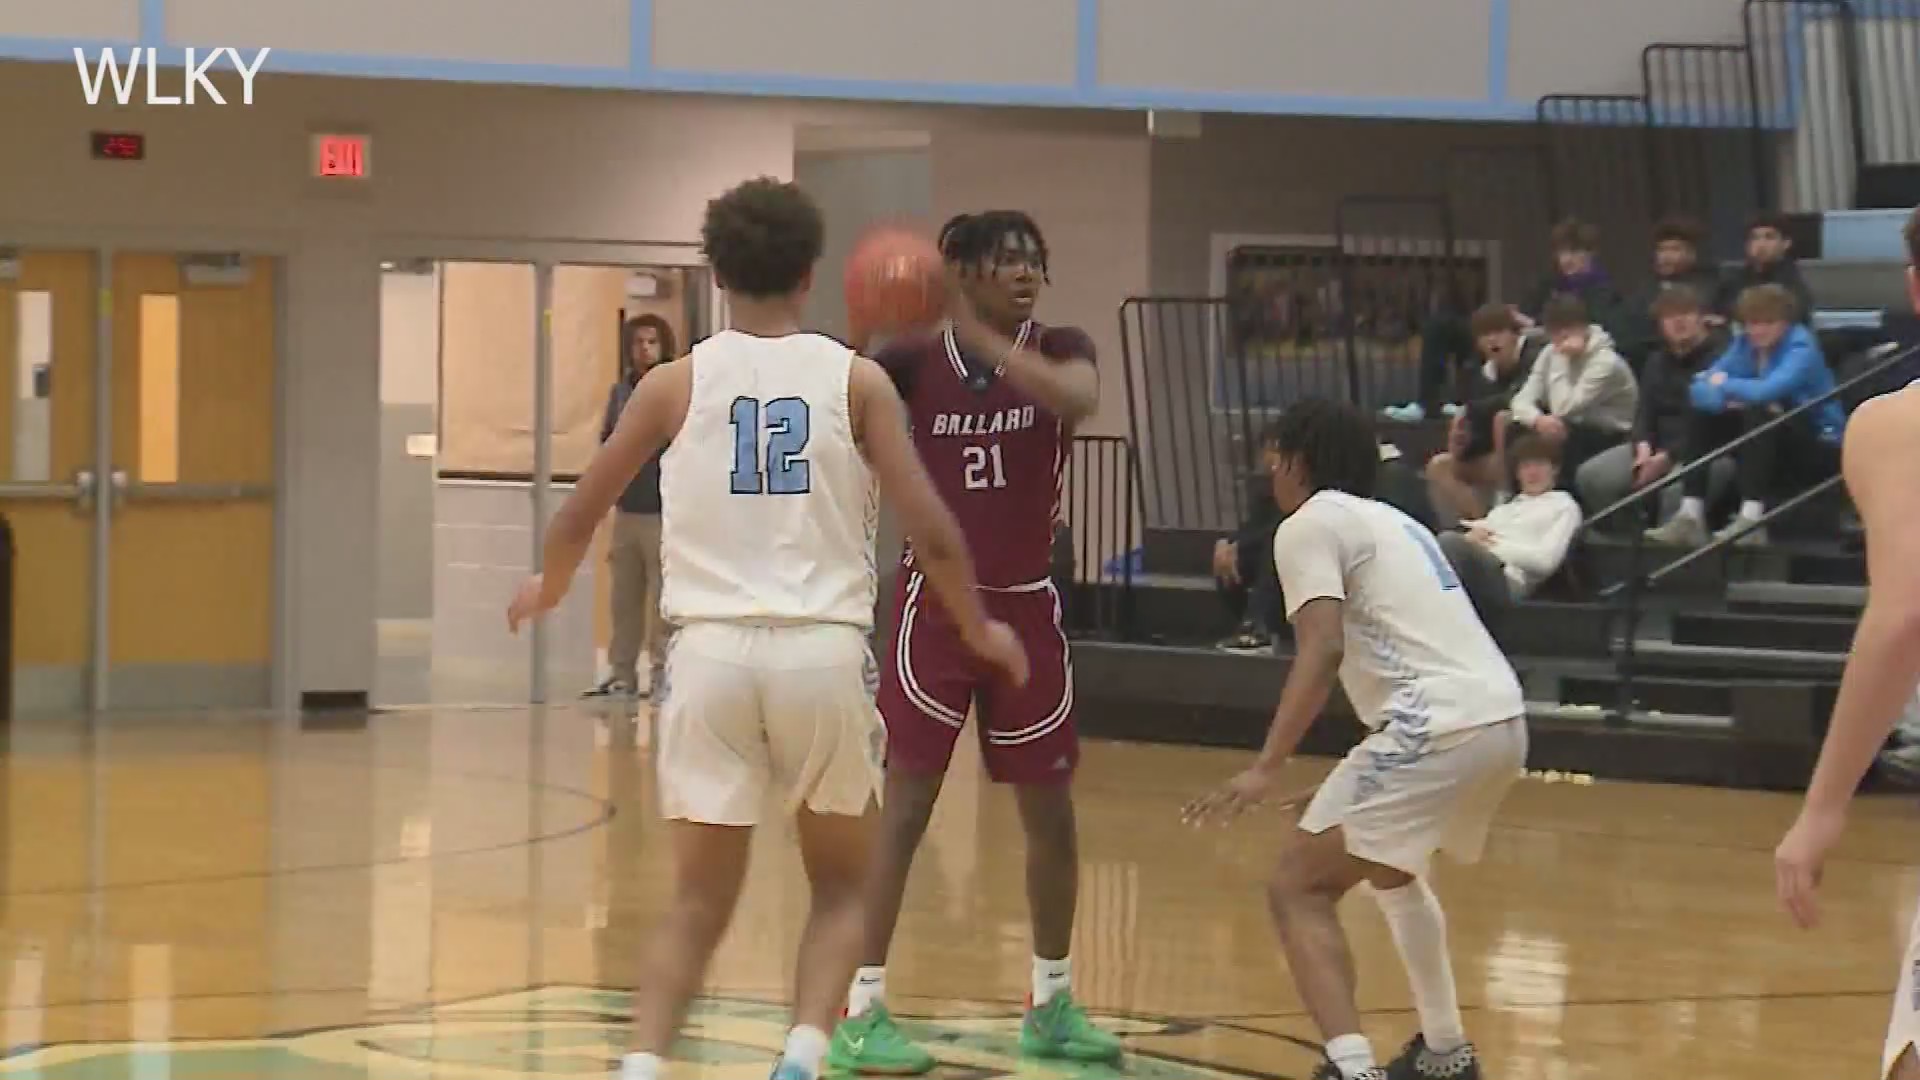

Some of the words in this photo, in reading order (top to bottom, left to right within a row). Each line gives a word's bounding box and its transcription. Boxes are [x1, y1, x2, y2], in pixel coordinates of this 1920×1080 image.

[931, 405, 1036, 437] BALLARD
[730, 396, 811, 495] 12
[962, 443, 1008, 491] 21
